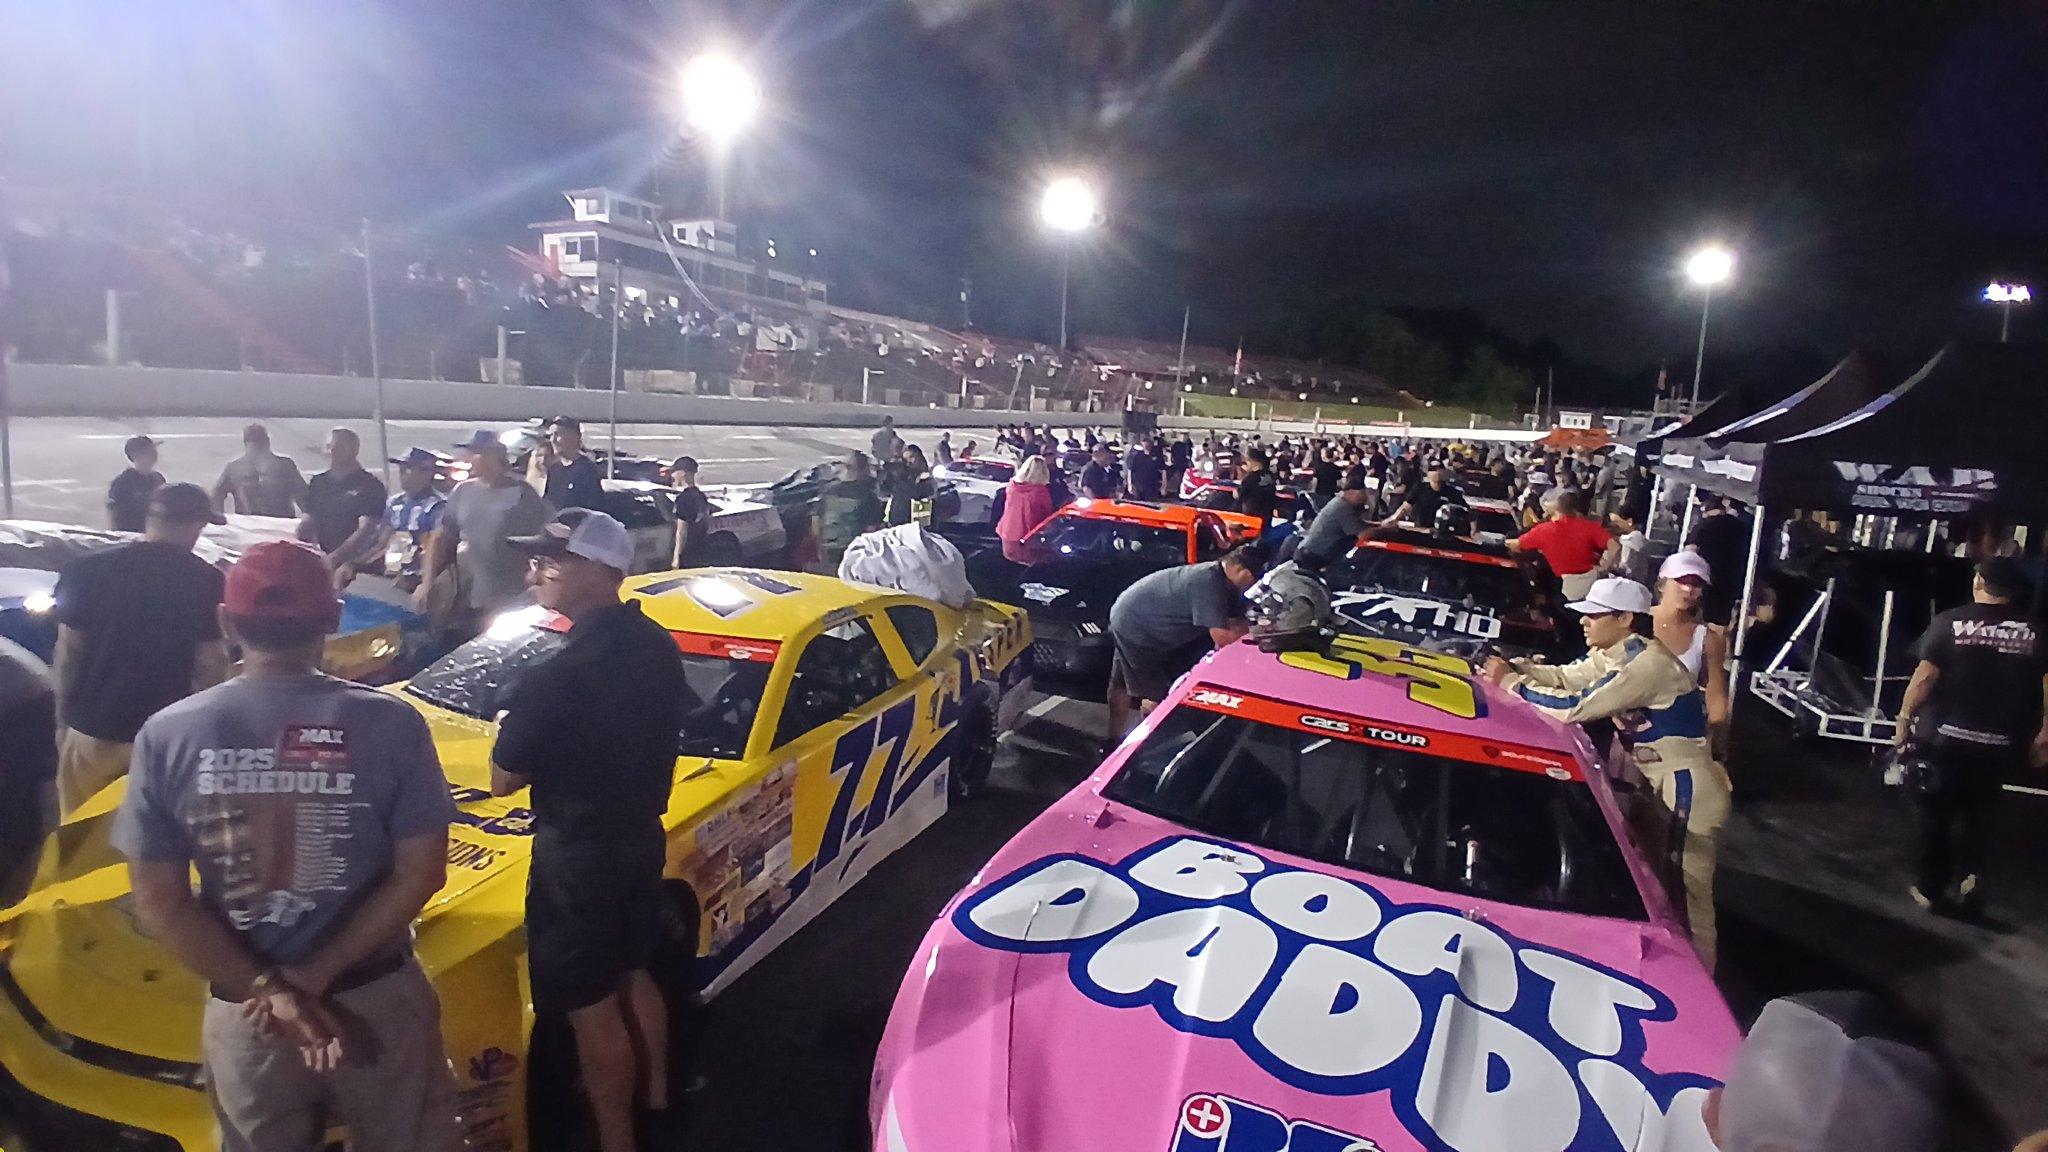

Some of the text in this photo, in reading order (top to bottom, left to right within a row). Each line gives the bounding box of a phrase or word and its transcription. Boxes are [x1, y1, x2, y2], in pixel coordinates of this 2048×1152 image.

[1367, 727, 1427, 746] TOUR
[199, 748, 275, 772] 2025
[197, 771, 356, 795] SCHEDULE
[1130, 837, 1658, 1057] BOAT
